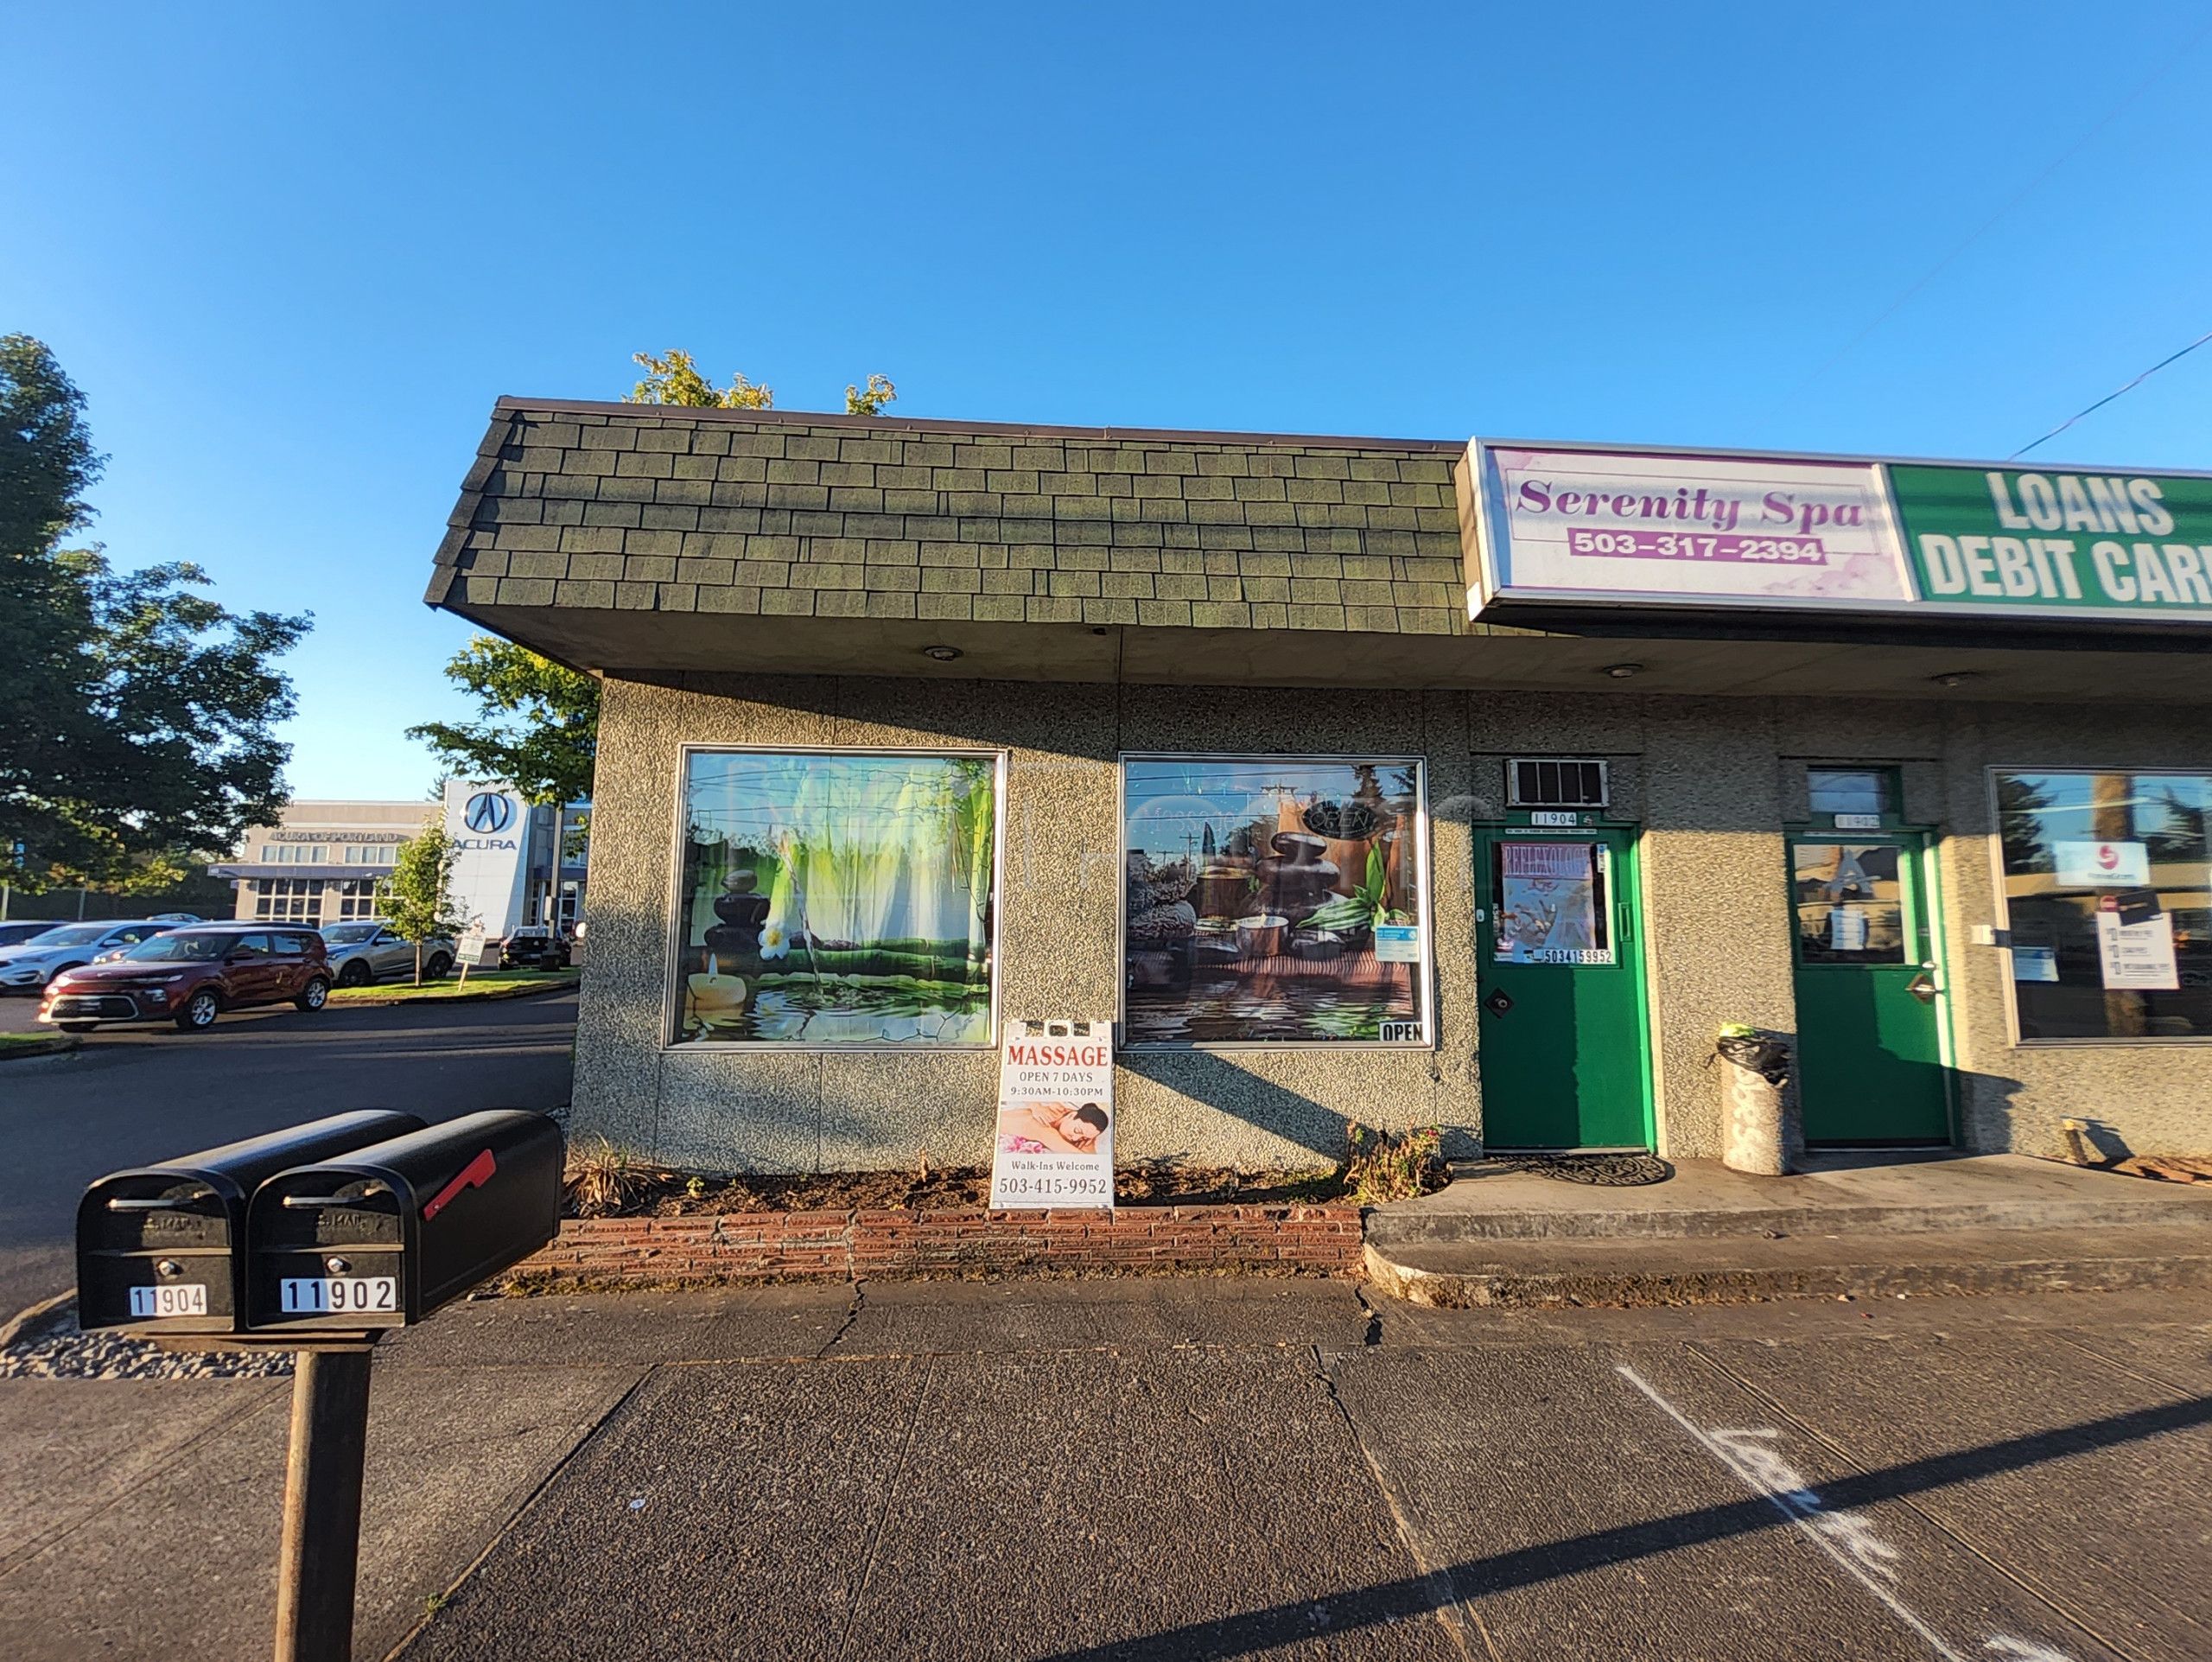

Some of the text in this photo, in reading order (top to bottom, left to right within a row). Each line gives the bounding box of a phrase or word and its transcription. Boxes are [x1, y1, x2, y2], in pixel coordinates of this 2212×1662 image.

[1515, 479, 1864, 534] Serenity Spa
[1986, 471, 2175, 536] LOANS
[1573, 532, 1822, 563] 503-317-2394
[1919, 533, 2083, 600] DEBIT
[1310, 812, 1370, 828] OPEN
[1535, 812, 1576, 825] 11904
[453, 838, 518, 850] ACURA
[1544, 950, 1612, 964] 5034159952
[1382, 1023, 1423, 1042] OPEN
[1007, 1045, 1108, 1067] MASSAGE
[1020, 1072, 1093, 1082] OPEN 7 DAYS
[1010, 1086, 1103, 1097] 9:30AM-10:30PM
[1012, 1160, 1100, 1171] Walk-Ins Welcome
[999, 1178, 1107, 1194] 503-415-9952
[132, 1287, 205, 1315] 11904
[286, 1280, 393, 1311] 11902
